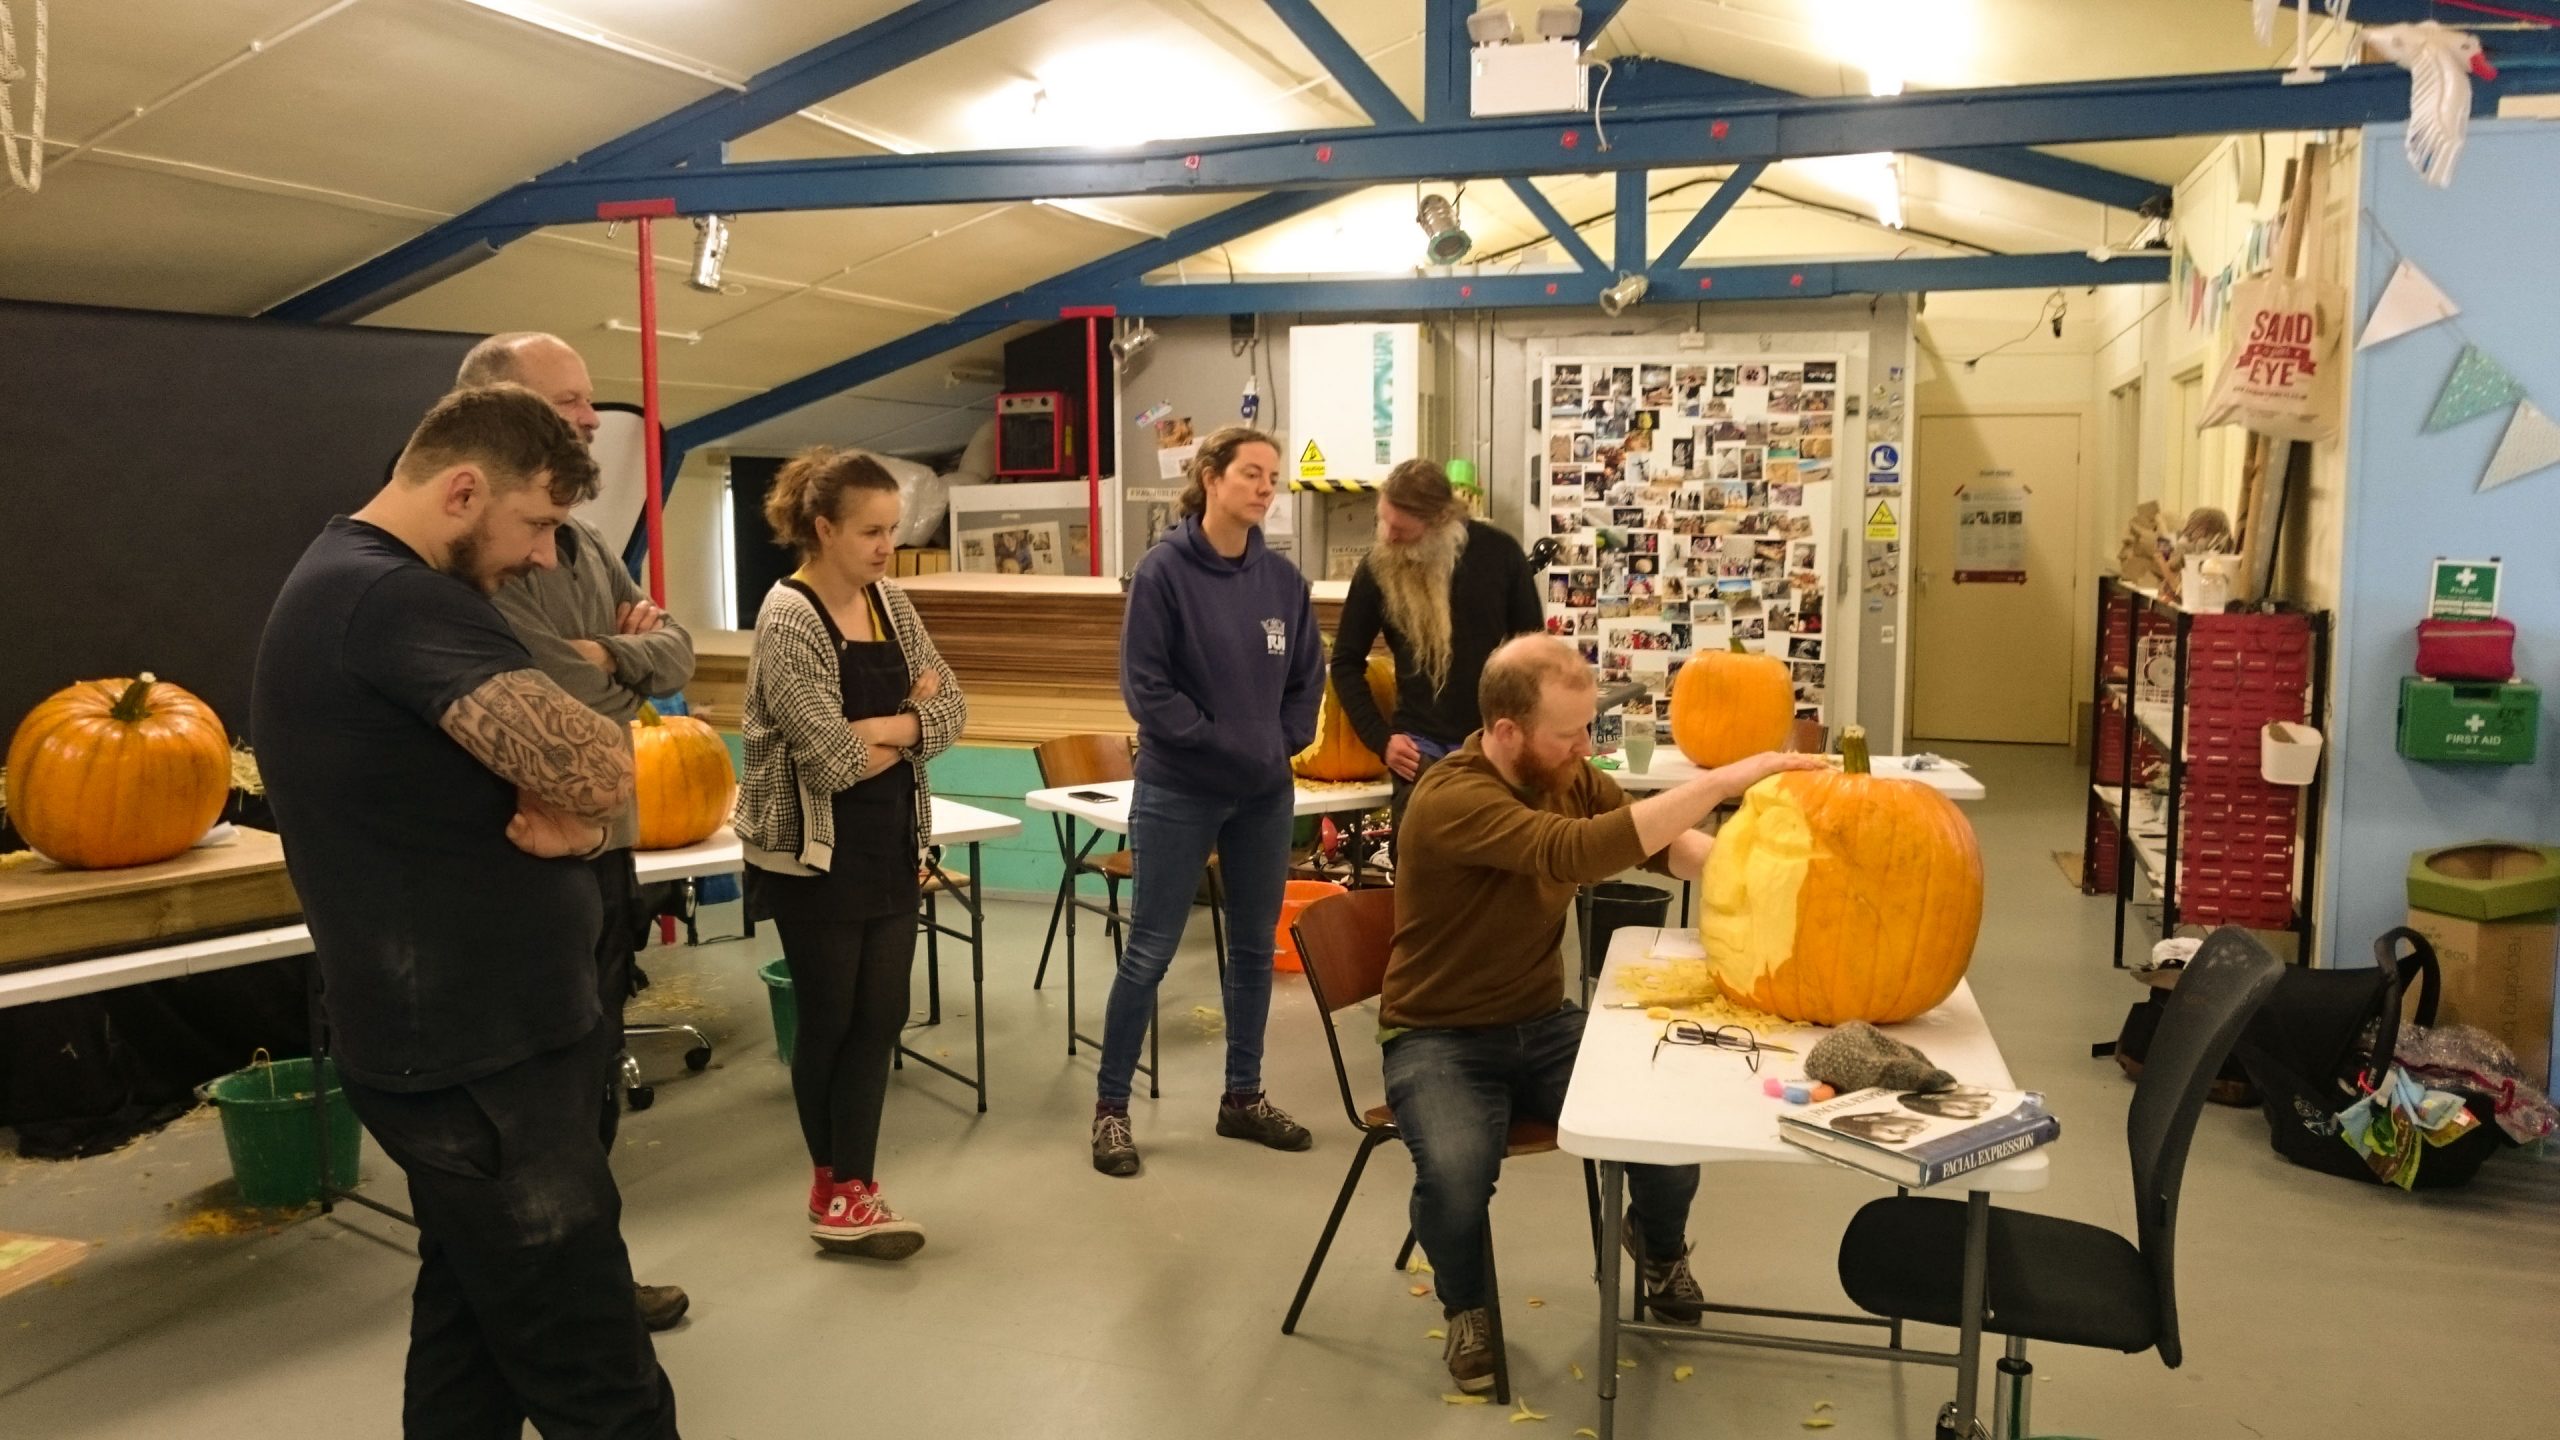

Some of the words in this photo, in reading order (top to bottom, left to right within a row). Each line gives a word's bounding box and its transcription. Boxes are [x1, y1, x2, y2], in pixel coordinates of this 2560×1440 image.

[2250, 310, 2312, 344] SAND
[2249, 359, 2295, 387] EYE
[2446, 733, 2479, 744] FIRST
[2481, 735, 2501, 745] AID
[1942, 1152, 1977, 1178] FACIAL
[1978, 1131, 2034, 1166] EXPRESSION
